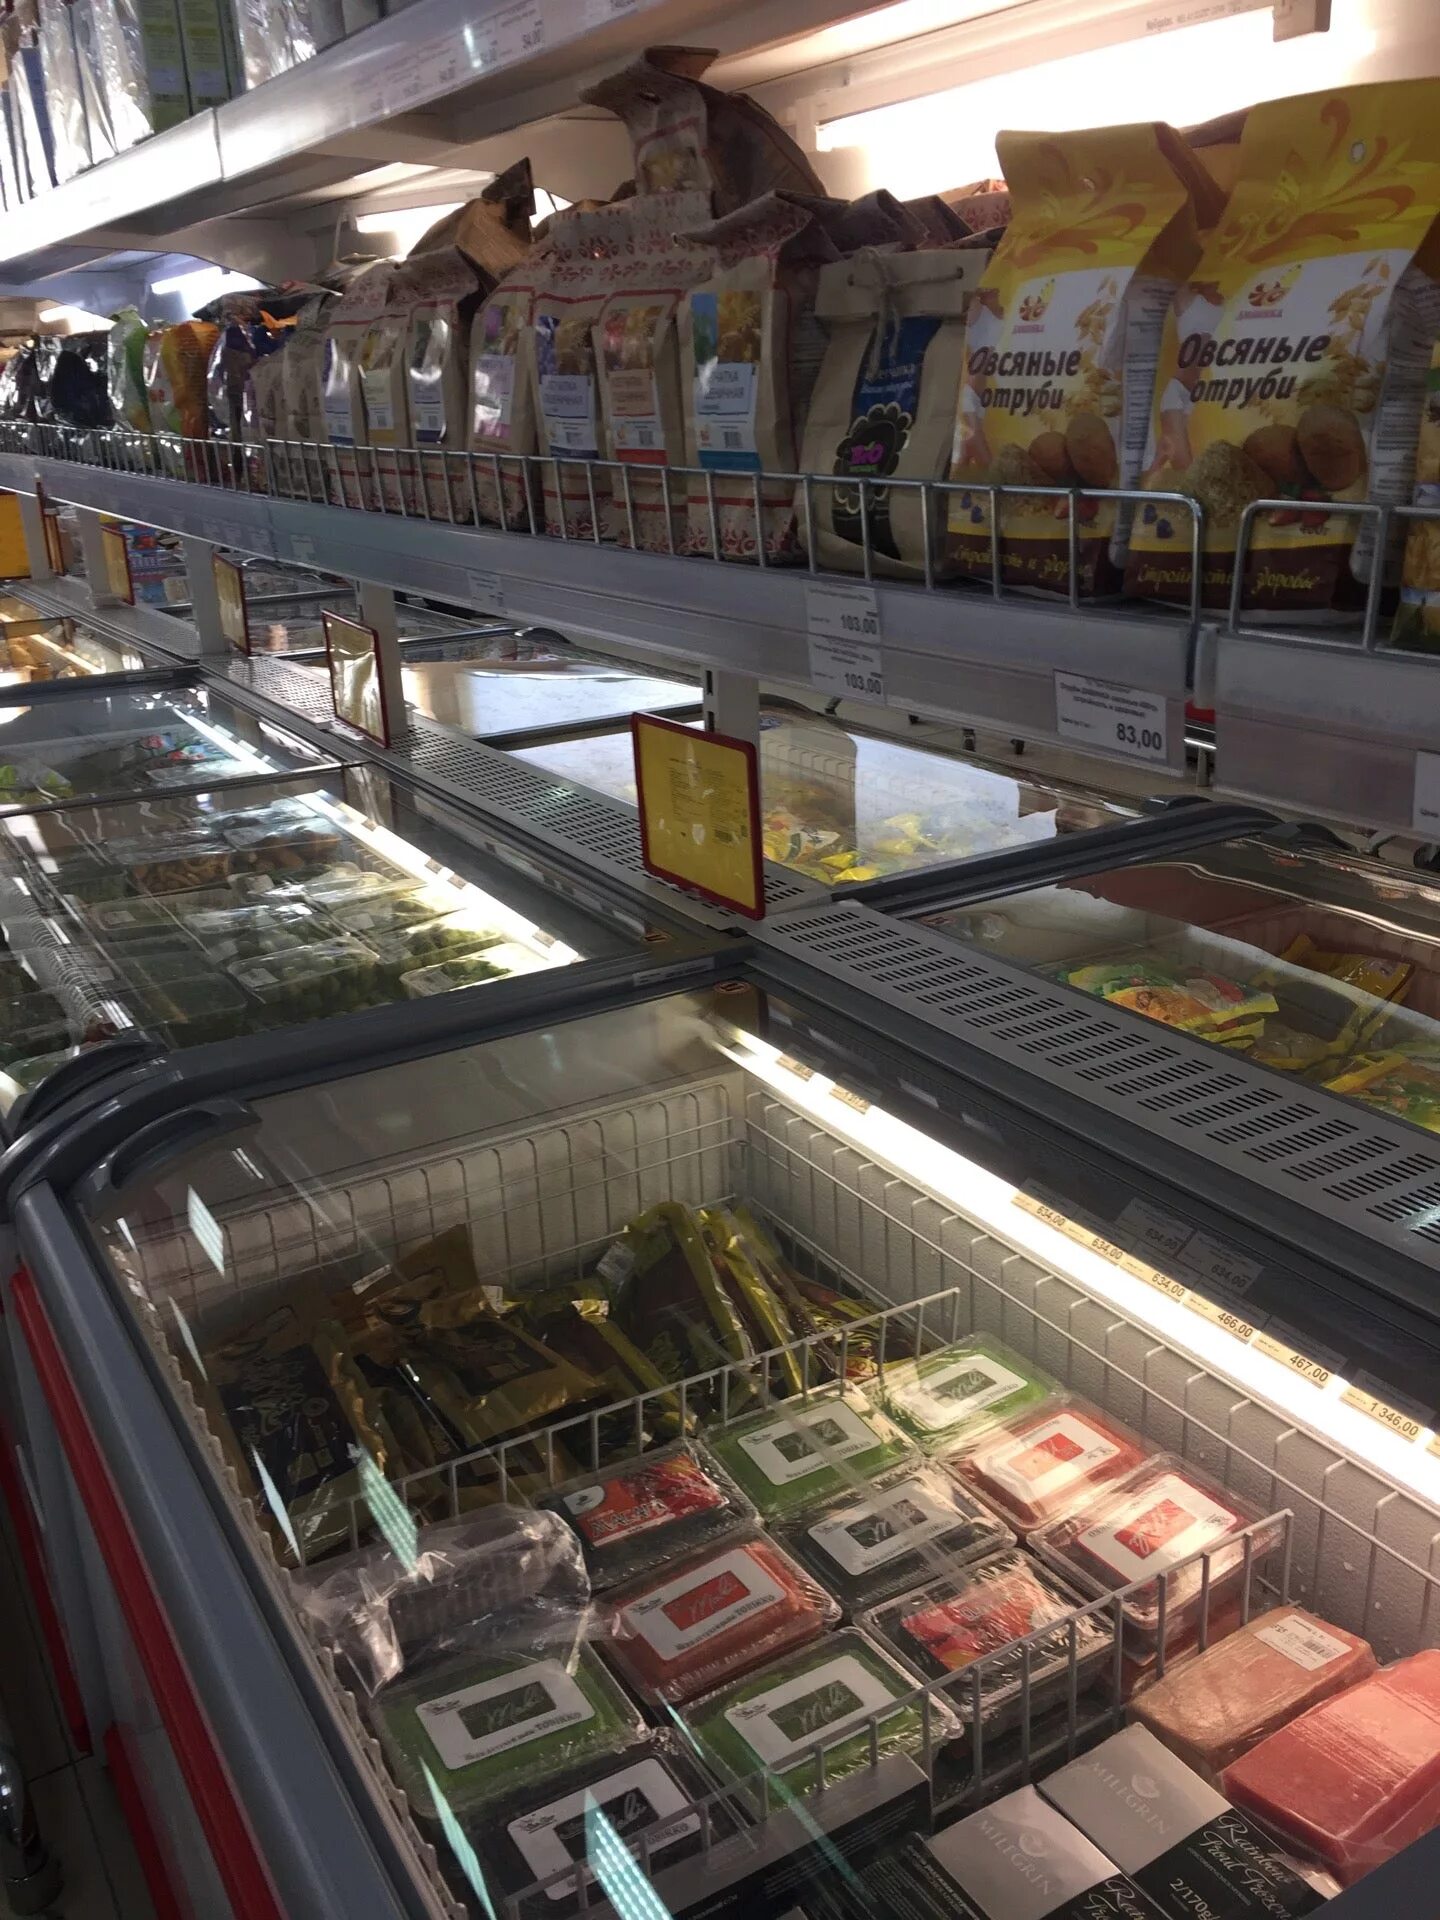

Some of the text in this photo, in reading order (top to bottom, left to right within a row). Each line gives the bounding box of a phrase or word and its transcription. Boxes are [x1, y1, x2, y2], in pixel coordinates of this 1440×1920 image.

[968, 346, 1081, 376] Овсяные
[1177, 333, 1331, 369] Овсяные
[981, 380, 1063, 416] отруби
[1189, 367, 1299, 410] отруби
[844, 672, 881, 696] 103,00
[1116, 722, 1163, 751] 83,00
[1036, 1205, 1066, 1227] 634,00
[1091, 1237, 1124, 1260] 634,00
[1151, 1272, 1186, 1298] 634,00
[1211, 1264, 1246, 1288] 634,00
[1217, 1311, 1254, 1338] 466,00
[1289, 1354, 1329, 1383] 467,00
[1217, 1815, 1297, 1885] Rainbow
